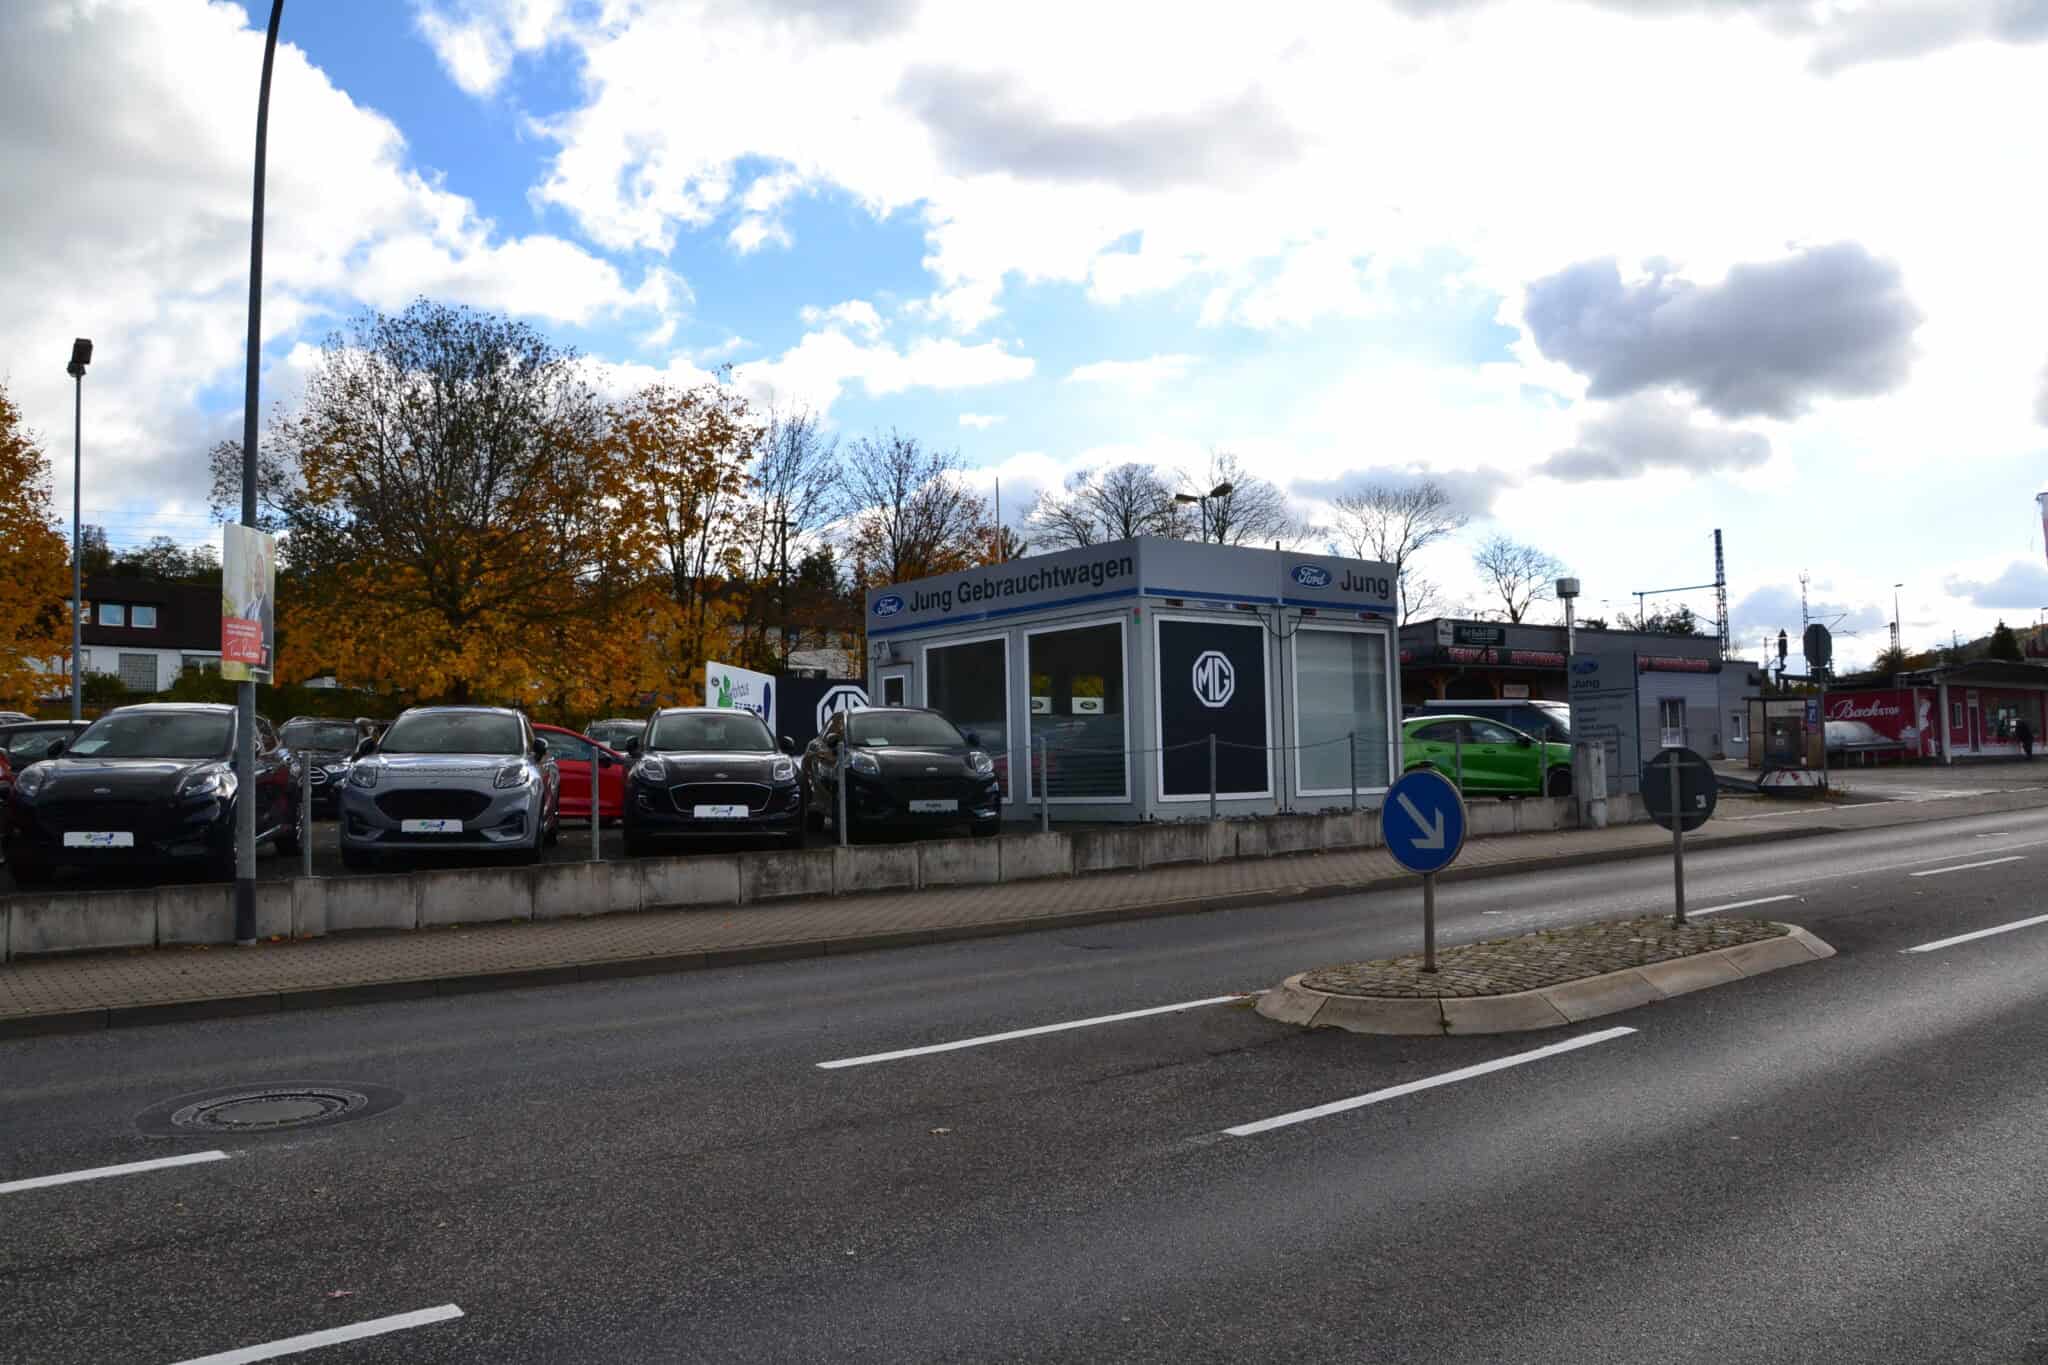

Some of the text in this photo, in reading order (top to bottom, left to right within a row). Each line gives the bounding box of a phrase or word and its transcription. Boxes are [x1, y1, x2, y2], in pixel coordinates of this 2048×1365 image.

[876, 556, 1133, 615] Ford Jung Gebrauchtwagen
[1296, 564, 1390, 600] Ford Jung
[1197, 656, 1231, 702] MG
